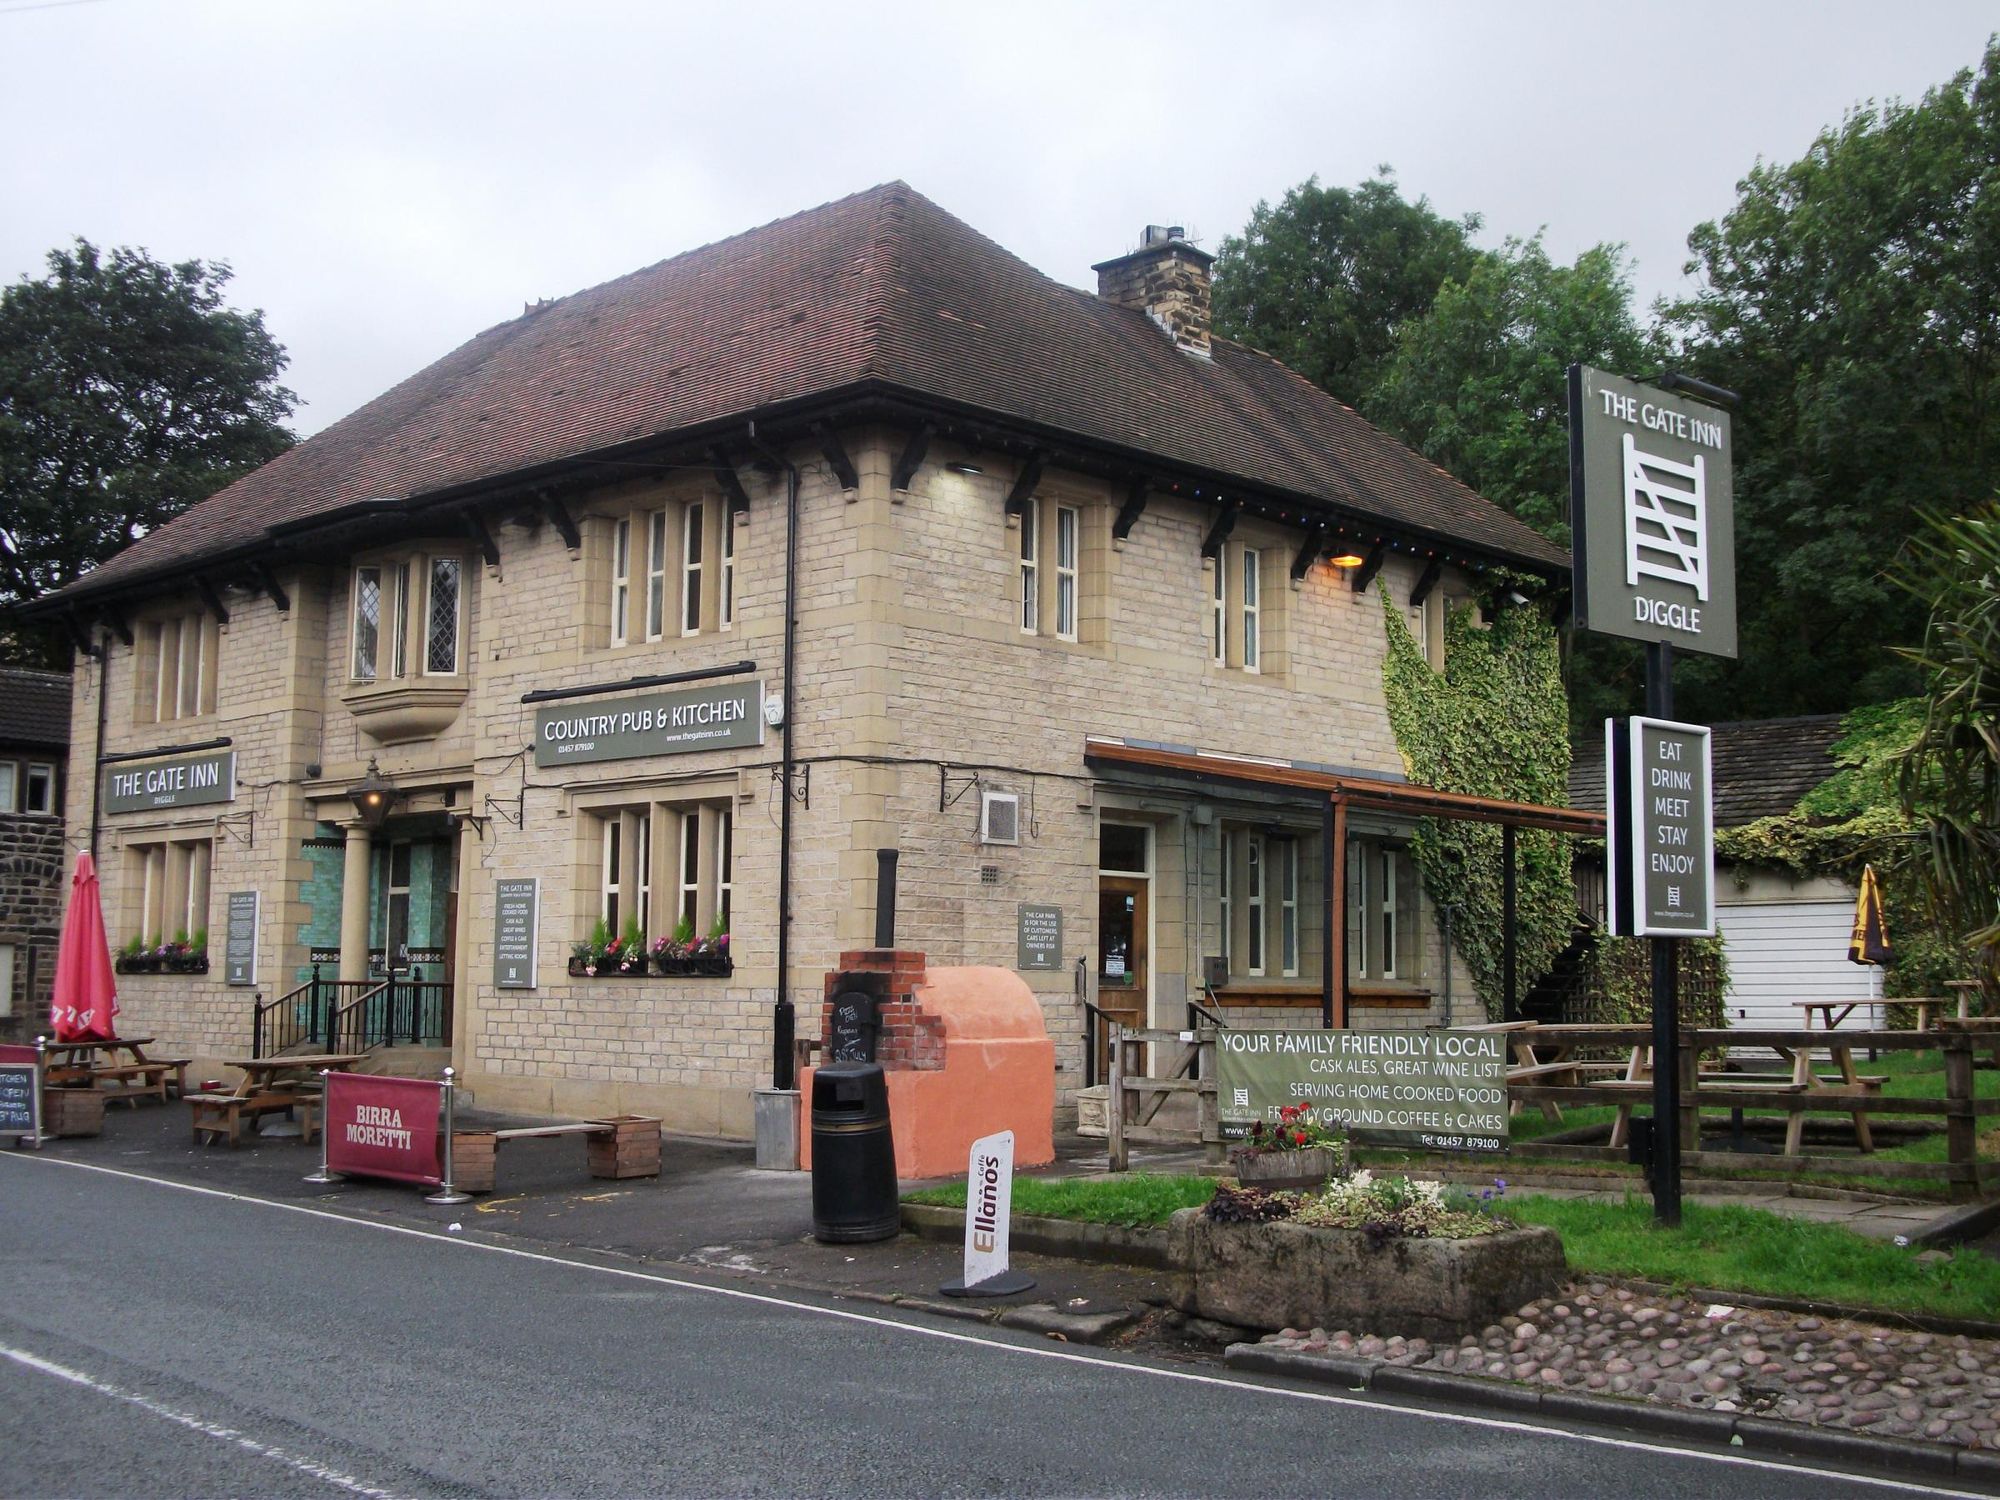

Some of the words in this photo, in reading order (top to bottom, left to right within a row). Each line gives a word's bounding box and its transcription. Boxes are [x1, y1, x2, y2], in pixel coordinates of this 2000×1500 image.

[1598, 389, 1638, 423] THE
[1641, 403, 1688, 438] GATE
[1689, 418, 1722, 450] INN
[1634, 596, 1702, 633] DIGGLE
[544, 714, 618, 741] COUNTRY
[621, 710, 652, 732] PUB
[656, 708, 668, 728] &
[672, 698, 746, 726] KITCHEN
[666, 727, 732, 742] www.thegateinn.co.uk
[1659, 741, 1683, 761] EAT
[114, 772, 142, 797] THE
[146, 766, 185, 793] GATE
[190, 762, 219, 788] INN
[1651, 767, 1692, 791] DRINK
[1655, 796, 1690, 818] MEET
[1658, 825, 1688, 846] STAY
[1651, 853, 1695, 874] ENJOY
[1221, 1034, 1271, 1053] YOUR
[1275, 1034, 1336, 1054] FAMILY
[1341, 1035, 1430, 1056] FRIENDLY
[1436, 1037, 1500, 1057] LOCAL
[1310, 1058, 1343, 1073] CASK
[1346, 1059, 1380, 1076] ALES,
[1383, 1060, 1429, 1076] GREAT
[1432, 1061, 1469, 1077] WINE
[1473, 1063, 1501, 1078] LIST
[1289, 1082, 1345, 1098] SERVING
[1348, 1083, 1390, 1099] HOME
[1393, 1085, 1455, 1102] COOKED
[1458, 1088, 1502, 1103] FOOD
[356, 1104, 402, 1128] BIRRA
[1221, 1107, 1233, 1115] THE
[1233, 1107, 1248, 1116] GATE
[1267, 1105, 1320, 1121] FRHLY
[1323, 1107, 1384, 1124] GROUND
[1387, 1110, 1440, 1127] COFFEE
[1444, 1113, 1454, 1128] &
[1457, 1113, 1502, 1130] CAKES
[346, 1123, 412, 1150] MORETTI
[1436, 1135, 1463, 1147] 01457
[1466, 1137, 1499, 1149] 879100
[973, 1155, 999, 1253] Ellanos
